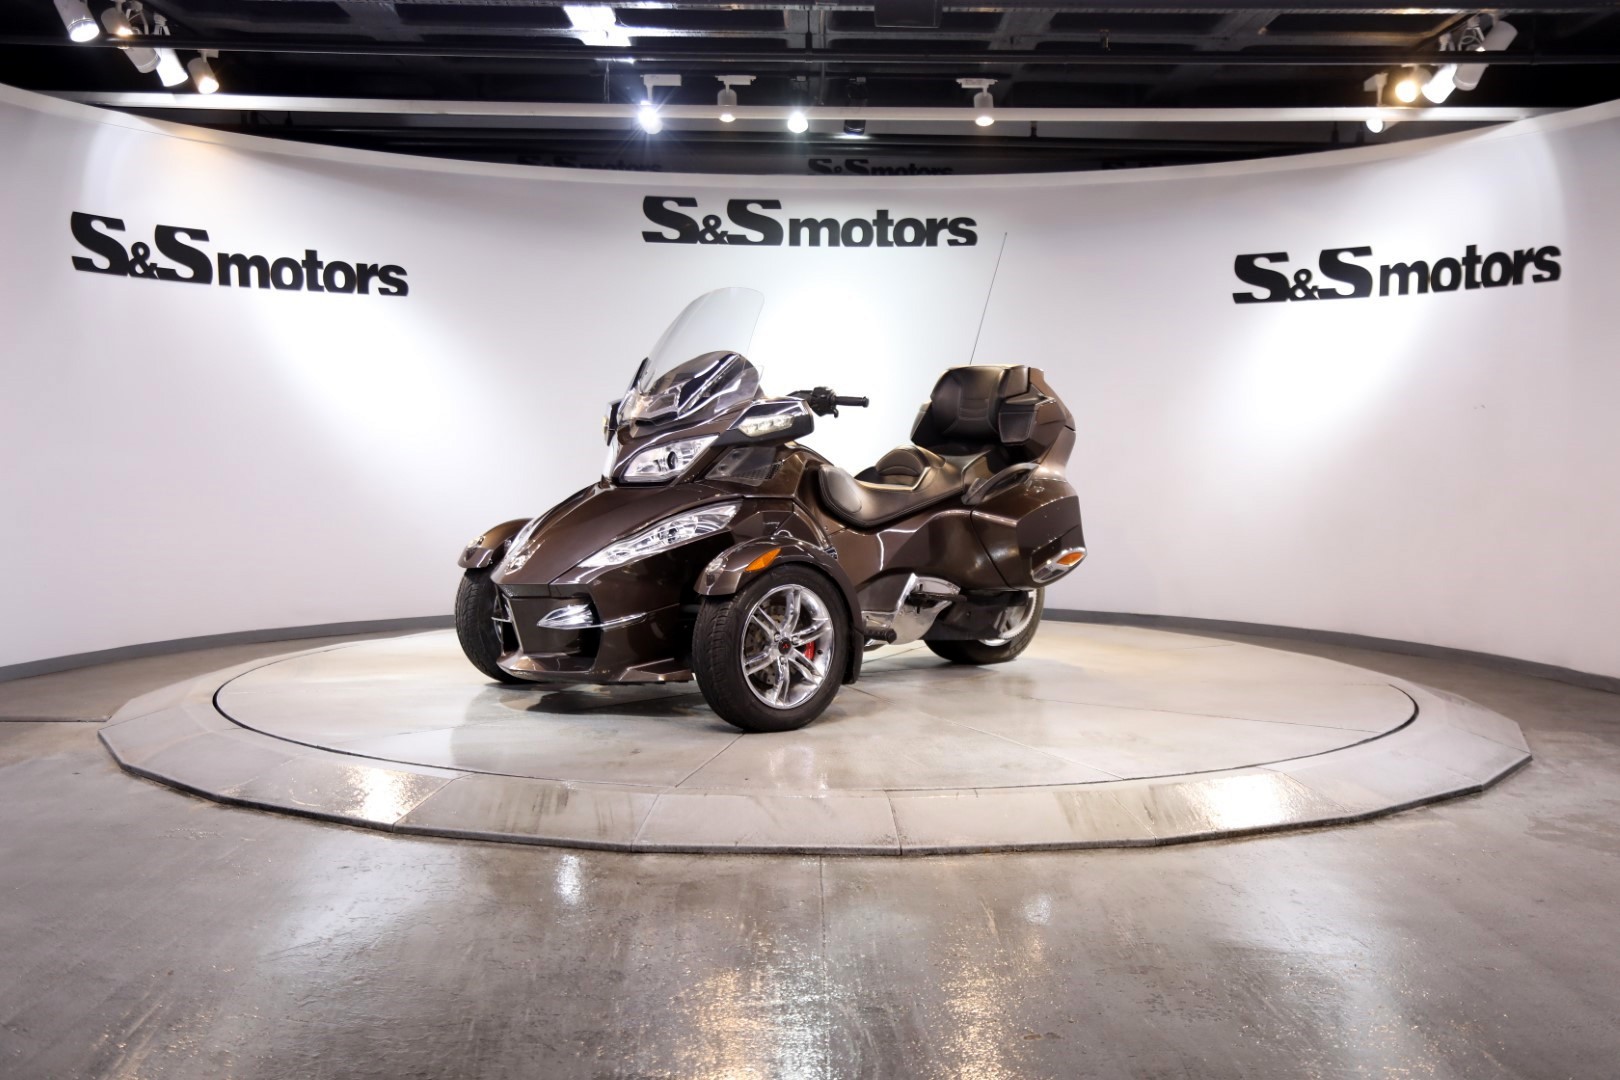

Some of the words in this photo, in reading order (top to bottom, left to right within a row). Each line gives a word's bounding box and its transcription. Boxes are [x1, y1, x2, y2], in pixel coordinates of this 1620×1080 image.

[642, 195, 784, 245] S&S
[789, 209, 978, 246] motors
[70, 211, 213, 285] S&S
[217, 249, 409, 296] motors
[1232, 246, 1373, 303] S&S
[1379, 244, 1562, 296] motors
